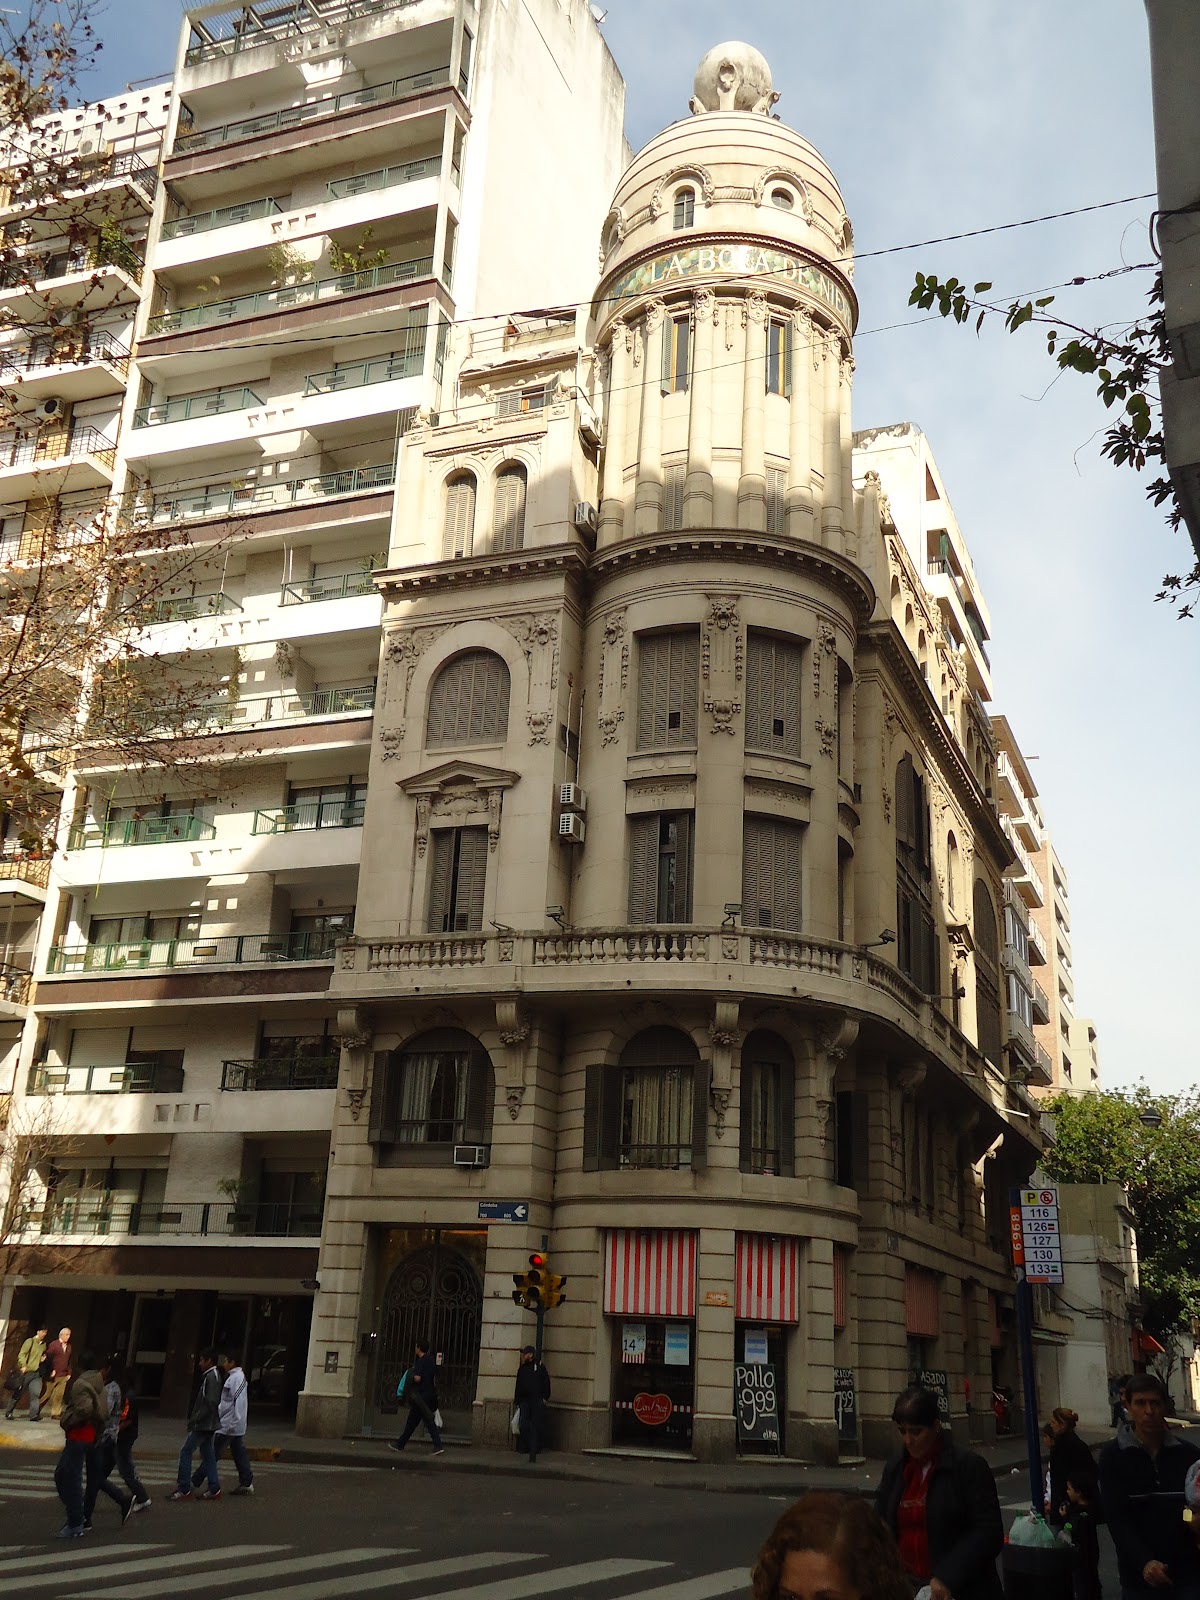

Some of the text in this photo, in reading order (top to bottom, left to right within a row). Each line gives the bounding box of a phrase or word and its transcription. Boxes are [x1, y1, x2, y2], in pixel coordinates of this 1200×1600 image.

[650, 254, 685, 284] LA
[782, 258, 811, 288] DE
[1027, 1193, 1036, 1203] P
[1030, 1208, 1049, 1218] 116
[1011, 1213, 1022, 1251] 6968
[1027, 1222, 1047, 1232] 126
[1032, 1236, 1052, 1246] 127
[1033, 1250, 1053, 1259] 130
[1030, 1264, 1051, 1274] 133
[735, 1364, 774, 1389] Pollo
[834, 1369, 853, 1379] RIZOS
